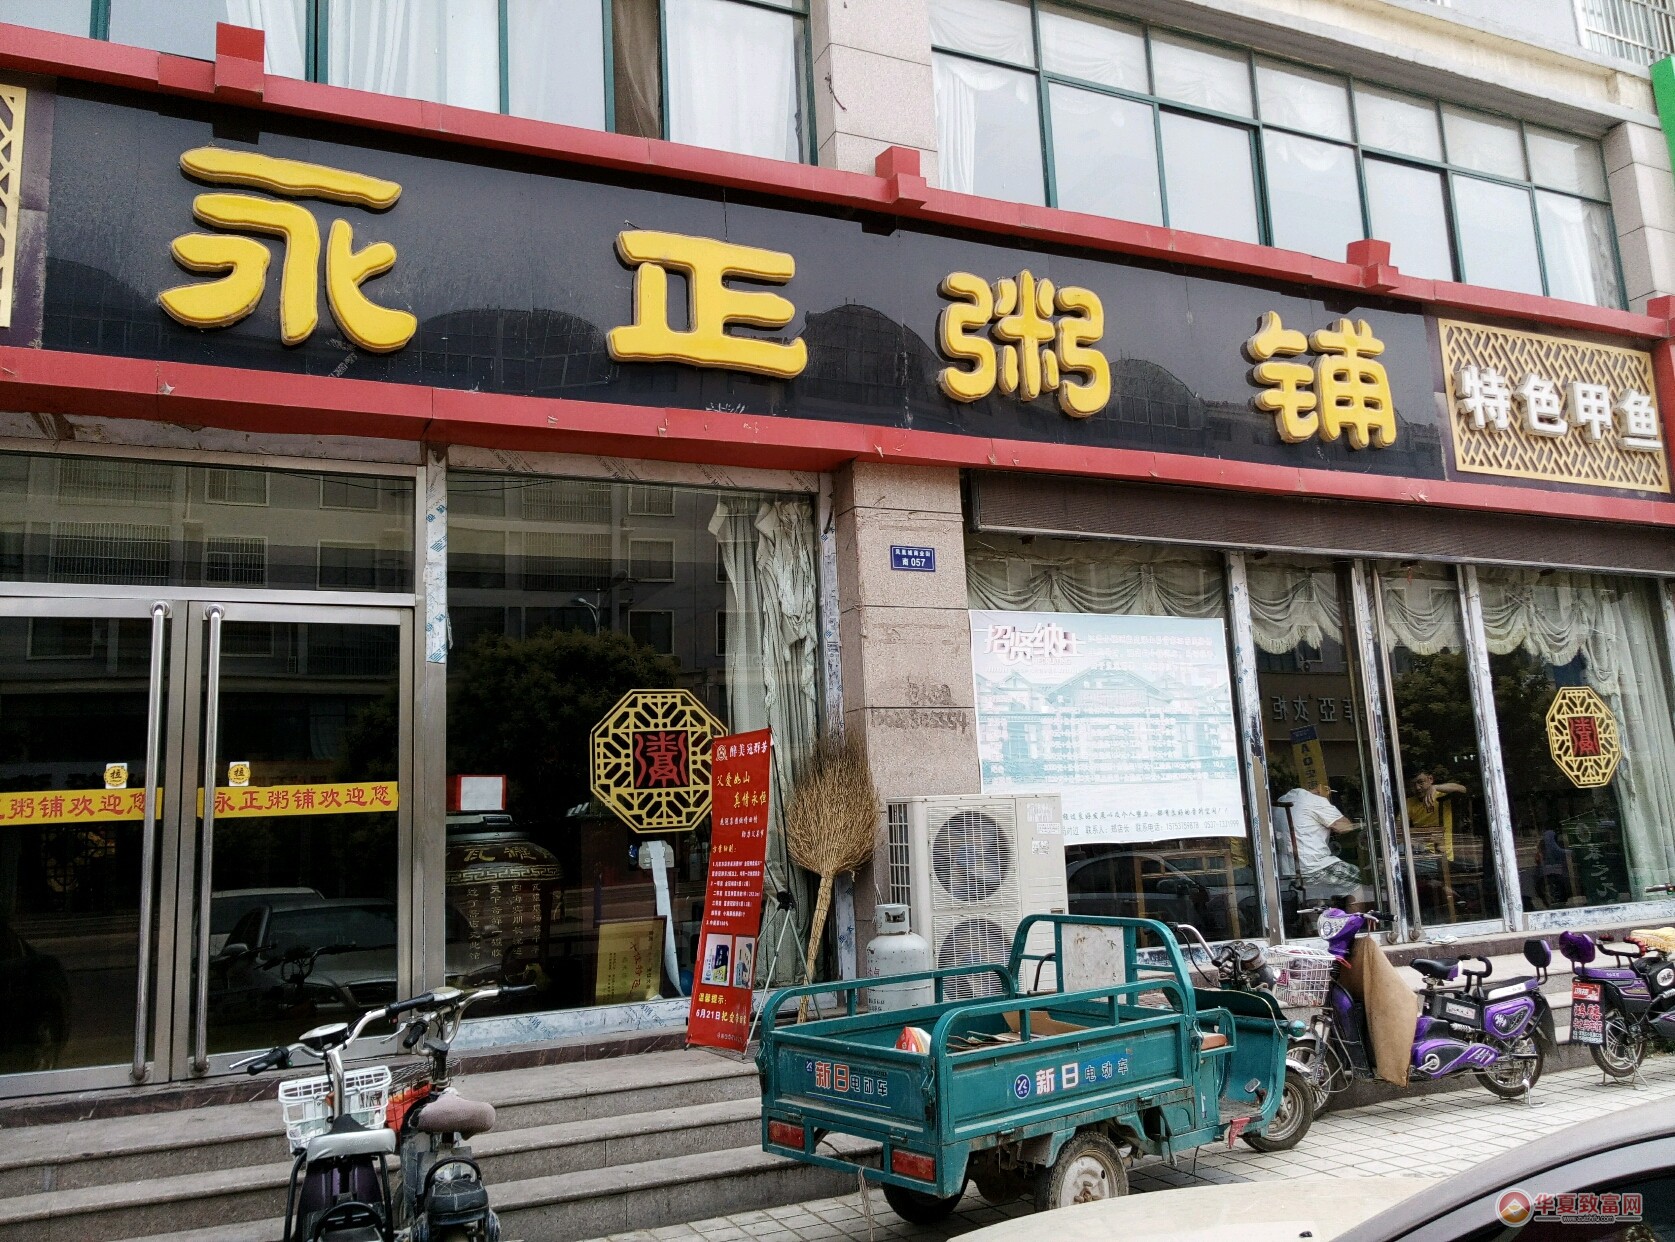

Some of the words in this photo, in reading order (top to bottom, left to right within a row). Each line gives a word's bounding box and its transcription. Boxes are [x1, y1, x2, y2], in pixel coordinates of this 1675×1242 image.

[158, 147, 1398, 449] 永正粥铺
[1454, 366, 1663, 453] 特色甲鱼
[911, 558, 926, 567] 057
[984, 622, 1087, 666] 招贤纳士
[716, 770, 751, 788] 父爱如山
[214, 784, 392, 814] 永正粥铺欢迎您
[733, 790, 767, 809] 真情永恒
[815, 1061, 888, 1097] 新日电动车
[1035, 1057, 1129, 1096] 新日电动车
